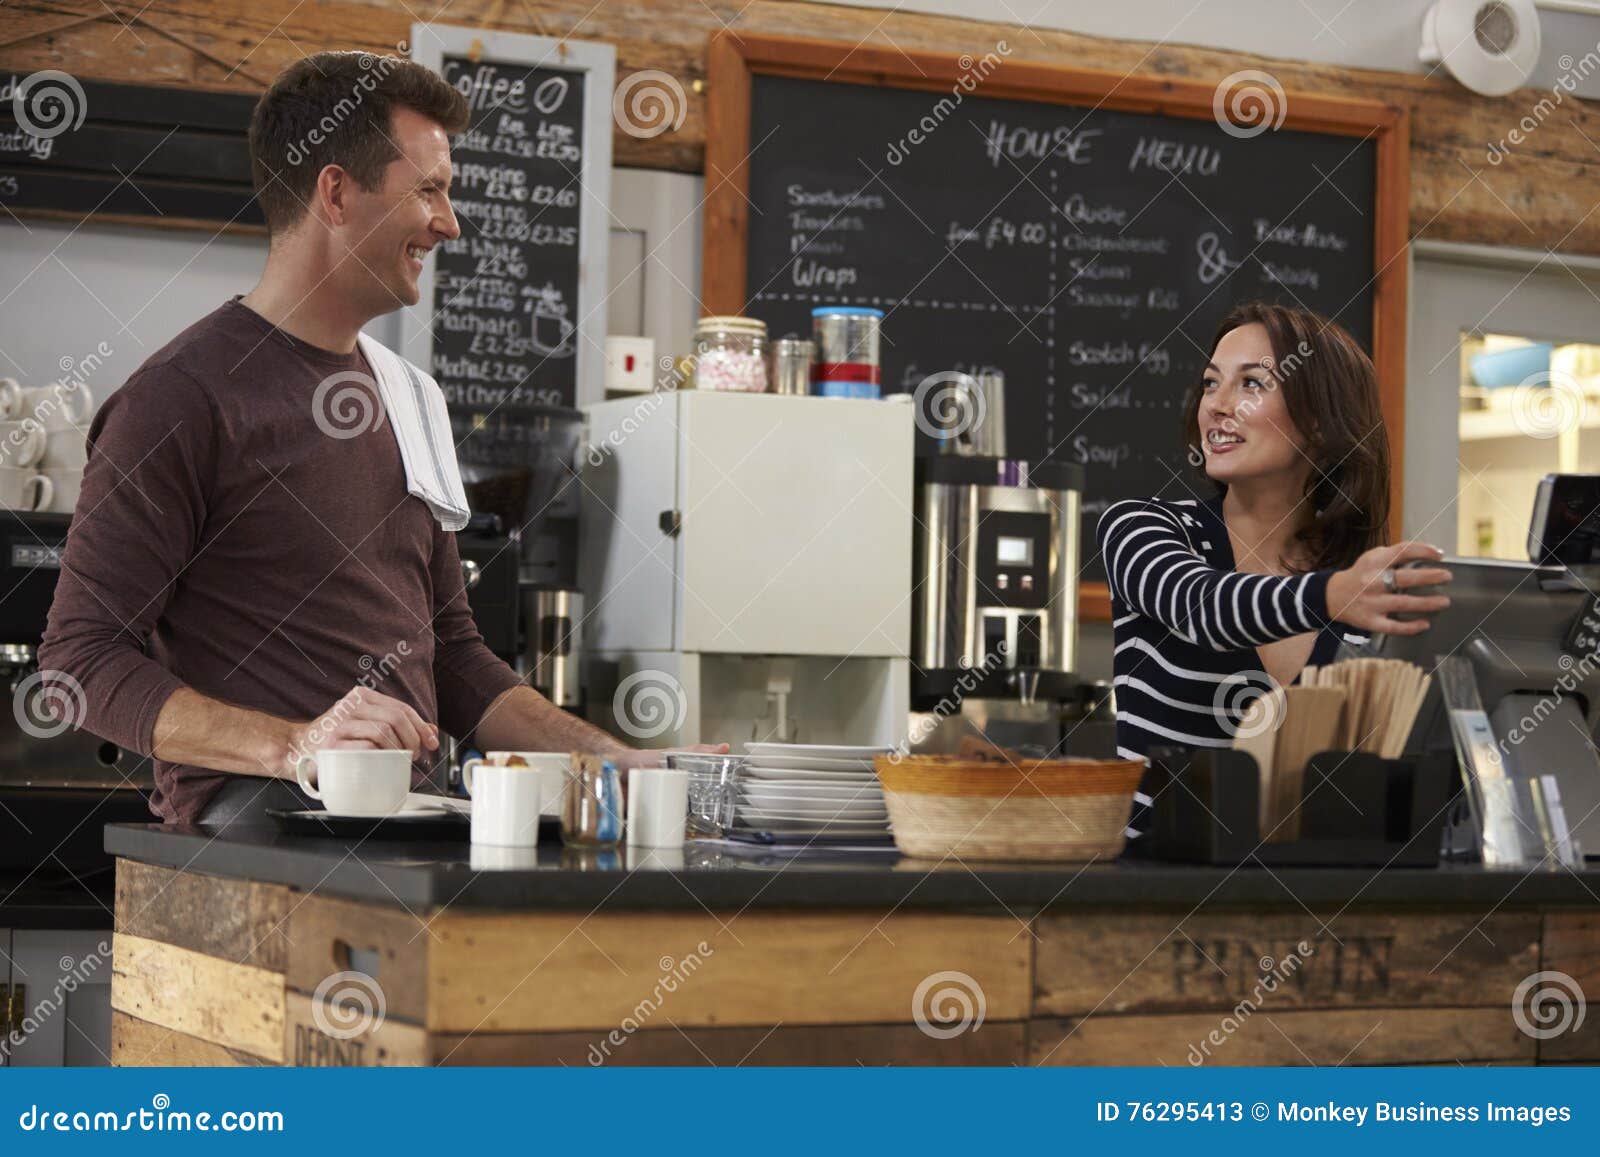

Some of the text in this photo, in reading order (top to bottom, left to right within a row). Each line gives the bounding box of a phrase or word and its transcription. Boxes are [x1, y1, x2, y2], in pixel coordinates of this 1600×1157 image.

[986, 119, 1220, 177] HOUSE MENU
[792, 258, 857, 291] Wraps
